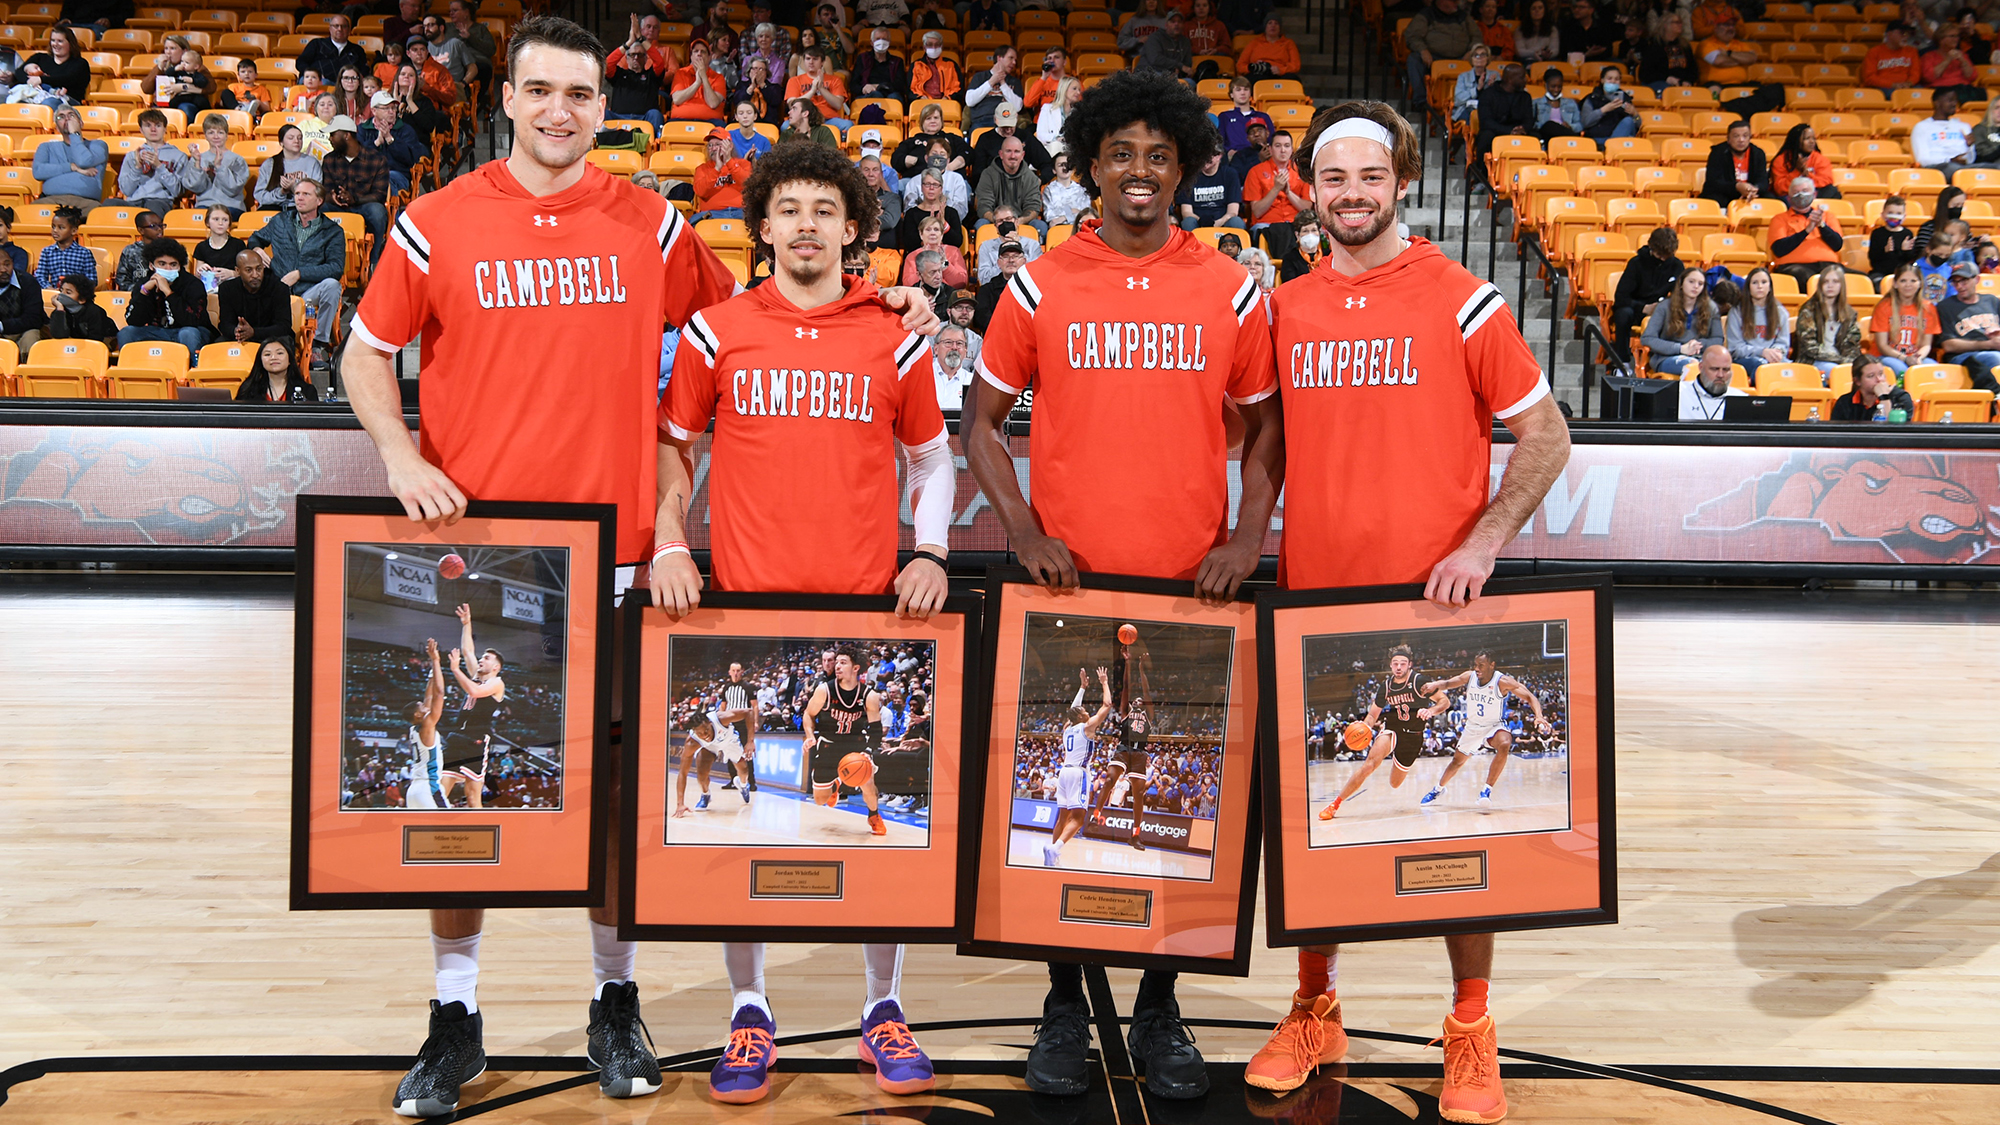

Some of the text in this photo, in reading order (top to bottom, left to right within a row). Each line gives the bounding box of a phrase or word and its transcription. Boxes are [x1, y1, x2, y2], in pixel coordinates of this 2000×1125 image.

[1189, 29, 1215, 41] EAGLE
[1877, 57, 1912, 70] CAMPBELL
[1194, 186, 1225, 195] LONGWOOD
[1194, 192, 1224, 202] LANCERS
[475, 256, 625, 308] CAMPBELL
[1899, 330, 1912, 345] 11
[1068, 322, 1205, 371] CAMPBELL
[1292, 337, 1417, 388] CAMPBELL
[734, 370, 872, 422] CAMPBELL
[389, 565, 433, 585] NCAA
[398, 584, 422, 596] 2003
[506, 589, 541, 607] NCAA
[1387, 692, 1415, 706] CAMPBELL
[1469, 692, 1495, 705] DUKE
[830, 708, 862, 721] CAMPBELL
[1395, 703, 1410, 721] 13
[1476, 703, 1484, 717] 3
[835, 721, 851, 734] 11
[1131, 719, 1145, 733] 45
[1066, 734, 1074, 752] 0
[1098, 895, 1126, 903] Henderson
